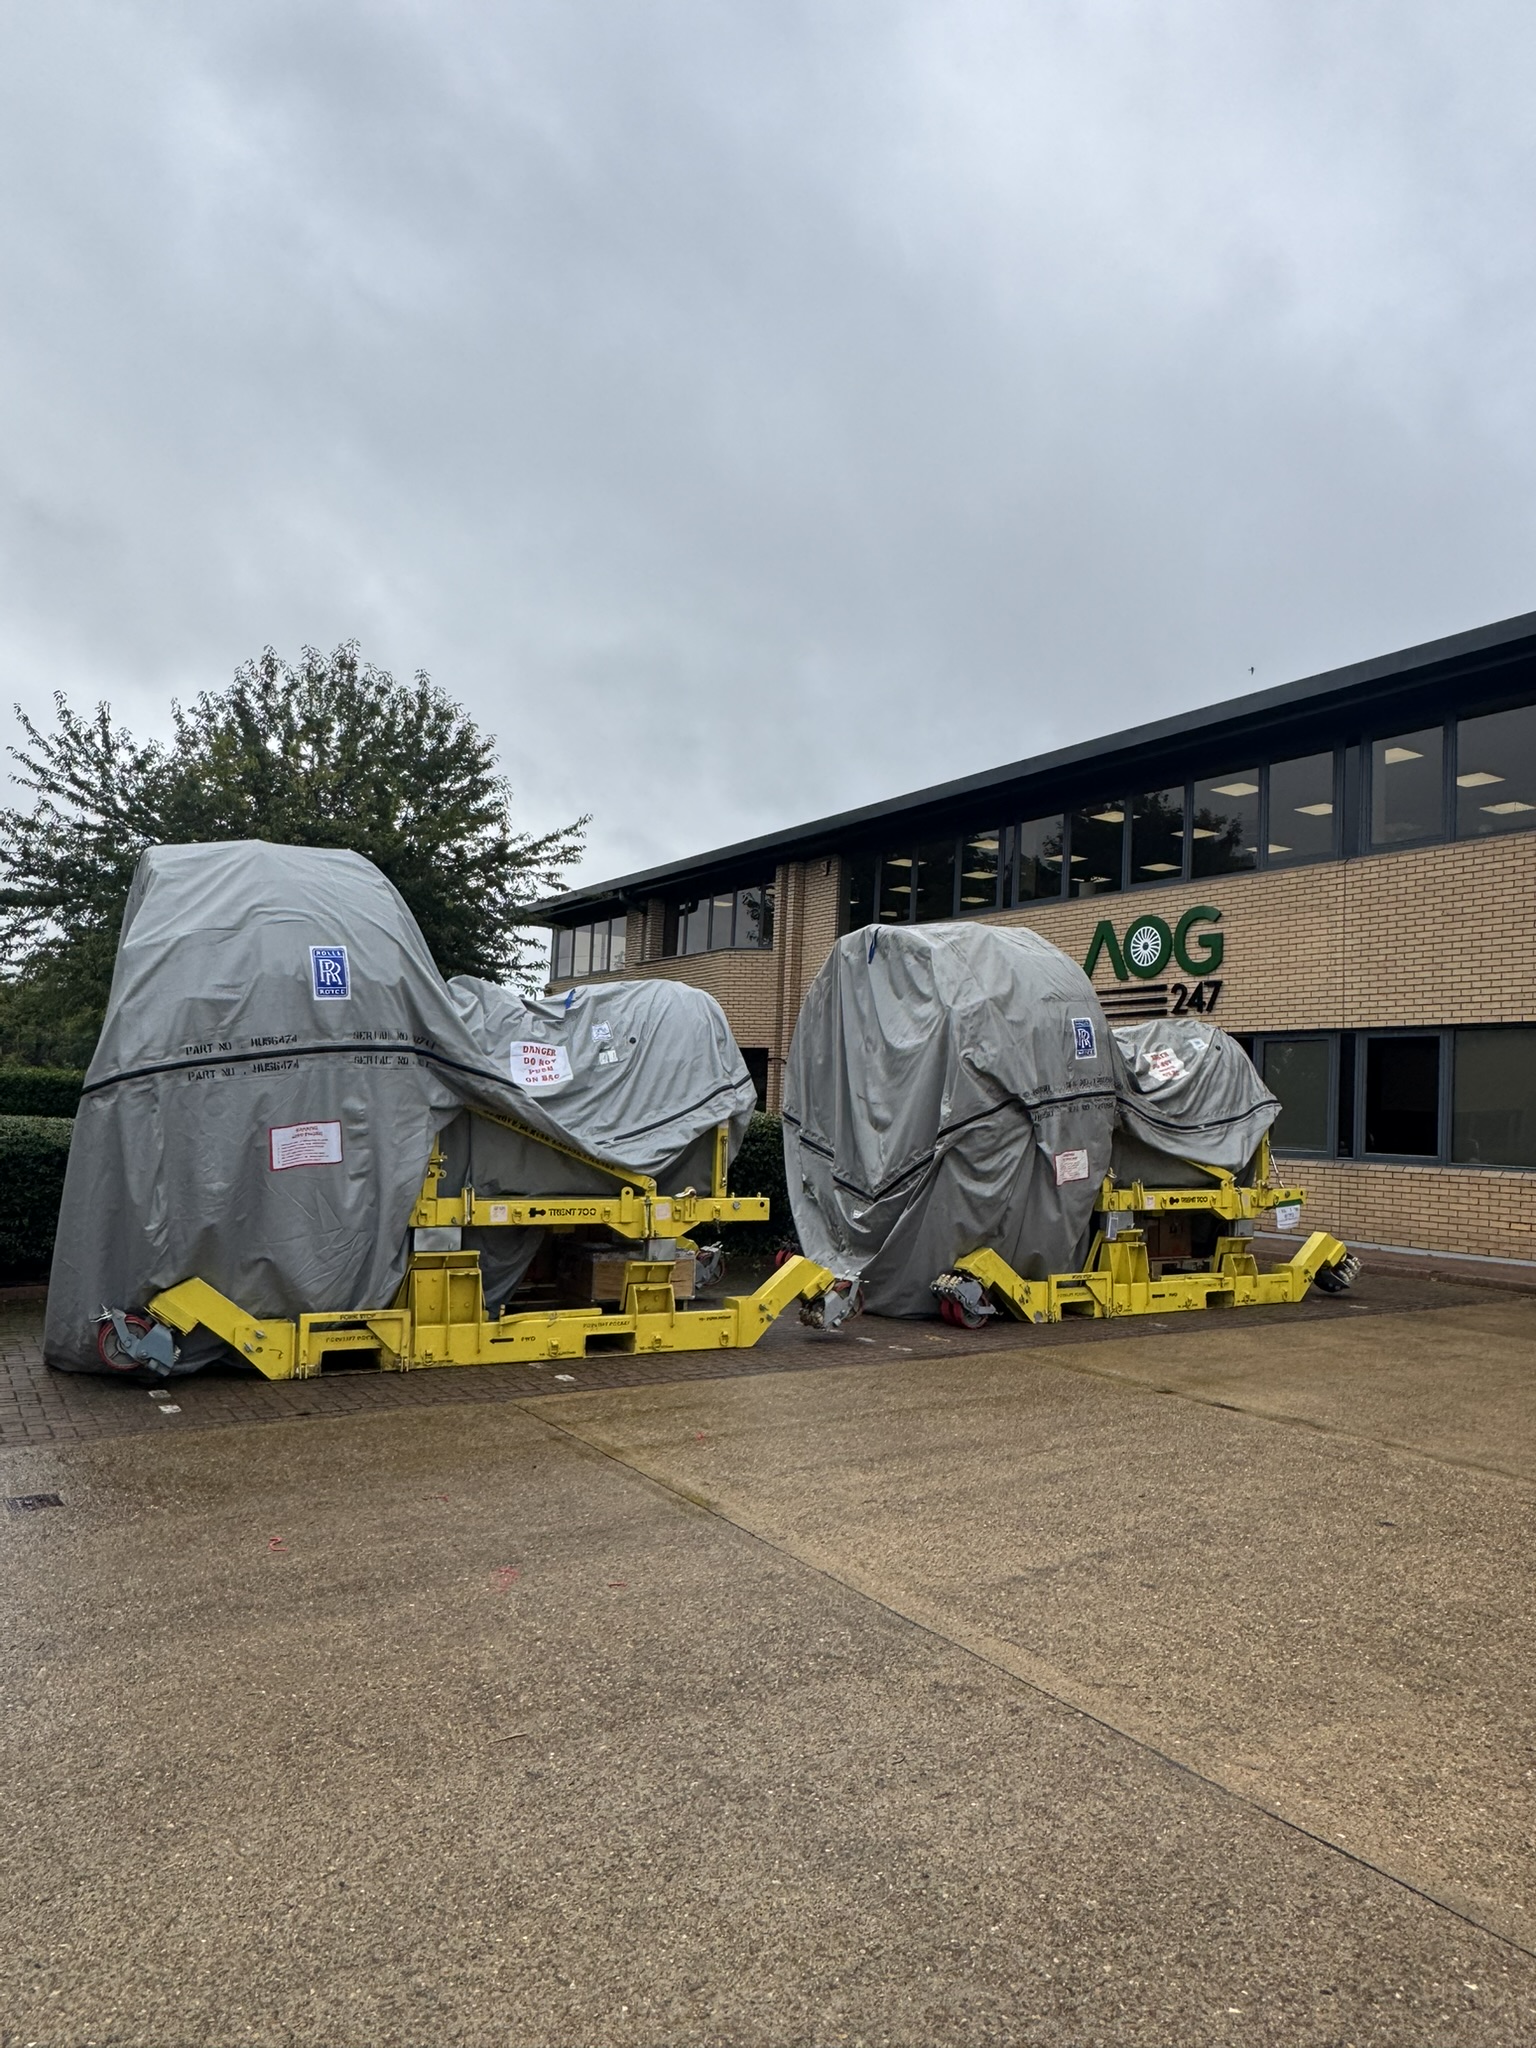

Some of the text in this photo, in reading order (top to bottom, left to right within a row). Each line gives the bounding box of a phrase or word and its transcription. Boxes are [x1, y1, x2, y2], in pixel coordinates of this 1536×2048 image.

[1083, 905, 1225, 981] AOG
[1170, 980, 1223, 1015] 247
[185, 1043, 213, 1056] PART
[522, 1045, 557, 1057] DANGER
[523, 1057, 536, 1066] DO
[187, 1069, 216, 1081] PART
[548, 1207, 597, 1217] TRENT 700
